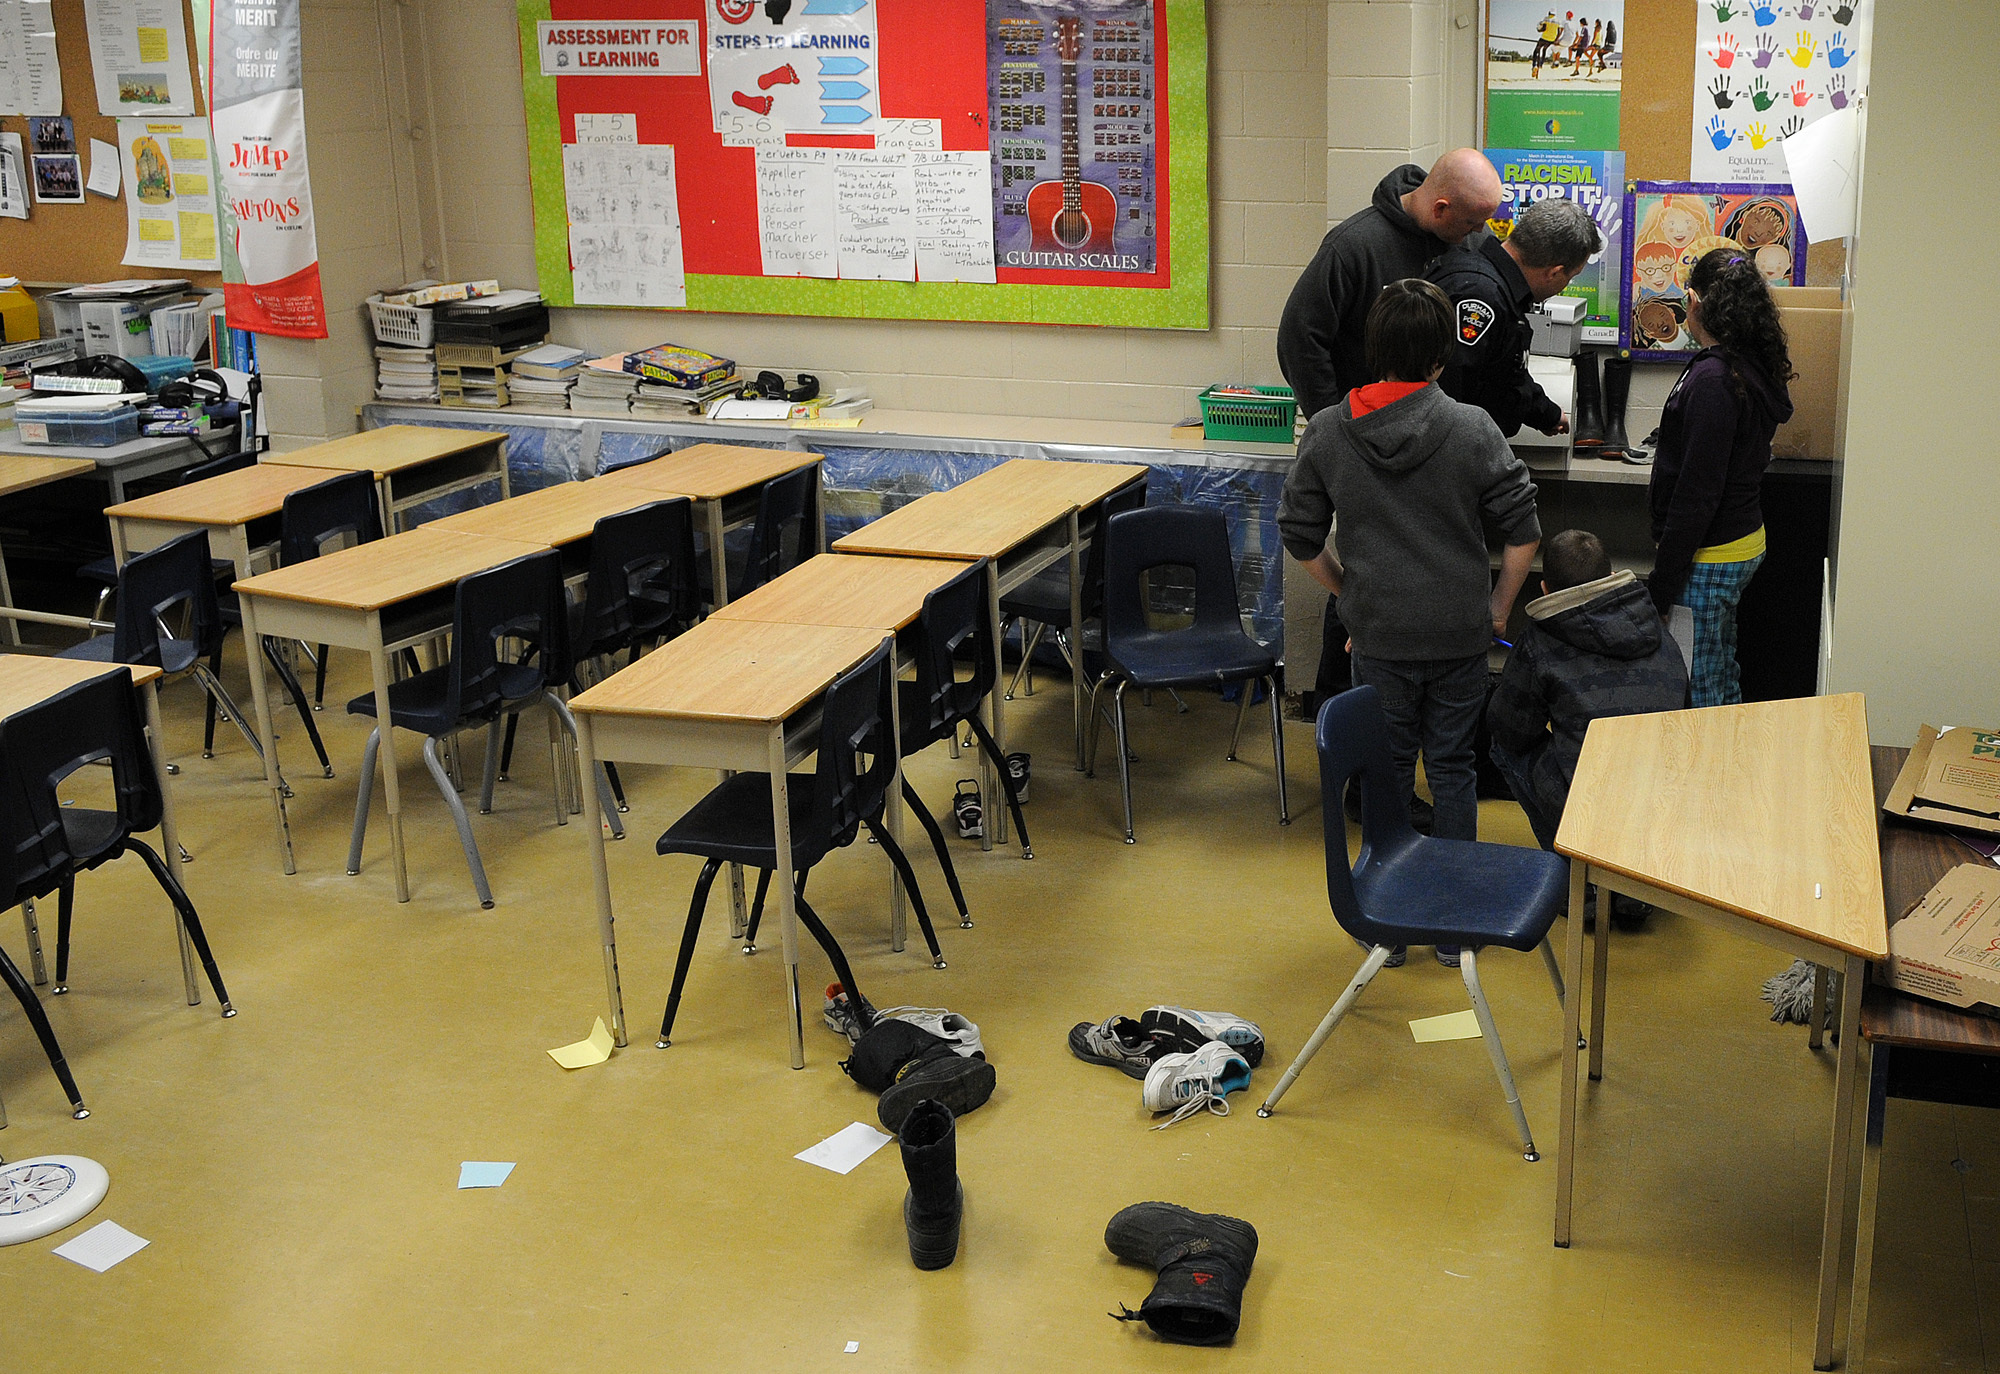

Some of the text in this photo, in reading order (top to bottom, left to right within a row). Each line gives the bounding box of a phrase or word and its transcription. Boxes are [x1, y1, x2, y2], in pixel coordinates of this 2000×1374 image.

[235, 9, 277, 26] MERIT
[547, 29, 690, 45] ASSESSMENT FOR
[715, 34, 870, 49] STEPS TO LEARNING
[236, 47, 279, 60] Ordre du
[578, 51, 660, 67] LEARNING
[236, 60, 277, 78] MÉRITE
[722, 132, 784, 147] Français
[876, 132, 935, 150] Français
[229, 143, 289, 171] JUMP
[1504, 163, 1597, 184] RACISM.
[1502, 183, 1602, 205] STOP IT!
[230, 196, 300, 223] SAUTONS
[1006, 250, 1139, 270] GUITAR SCALES
[1462, 303, 1492, 319] DURHAM
[1463, 315, 1485, 328] POLICE
